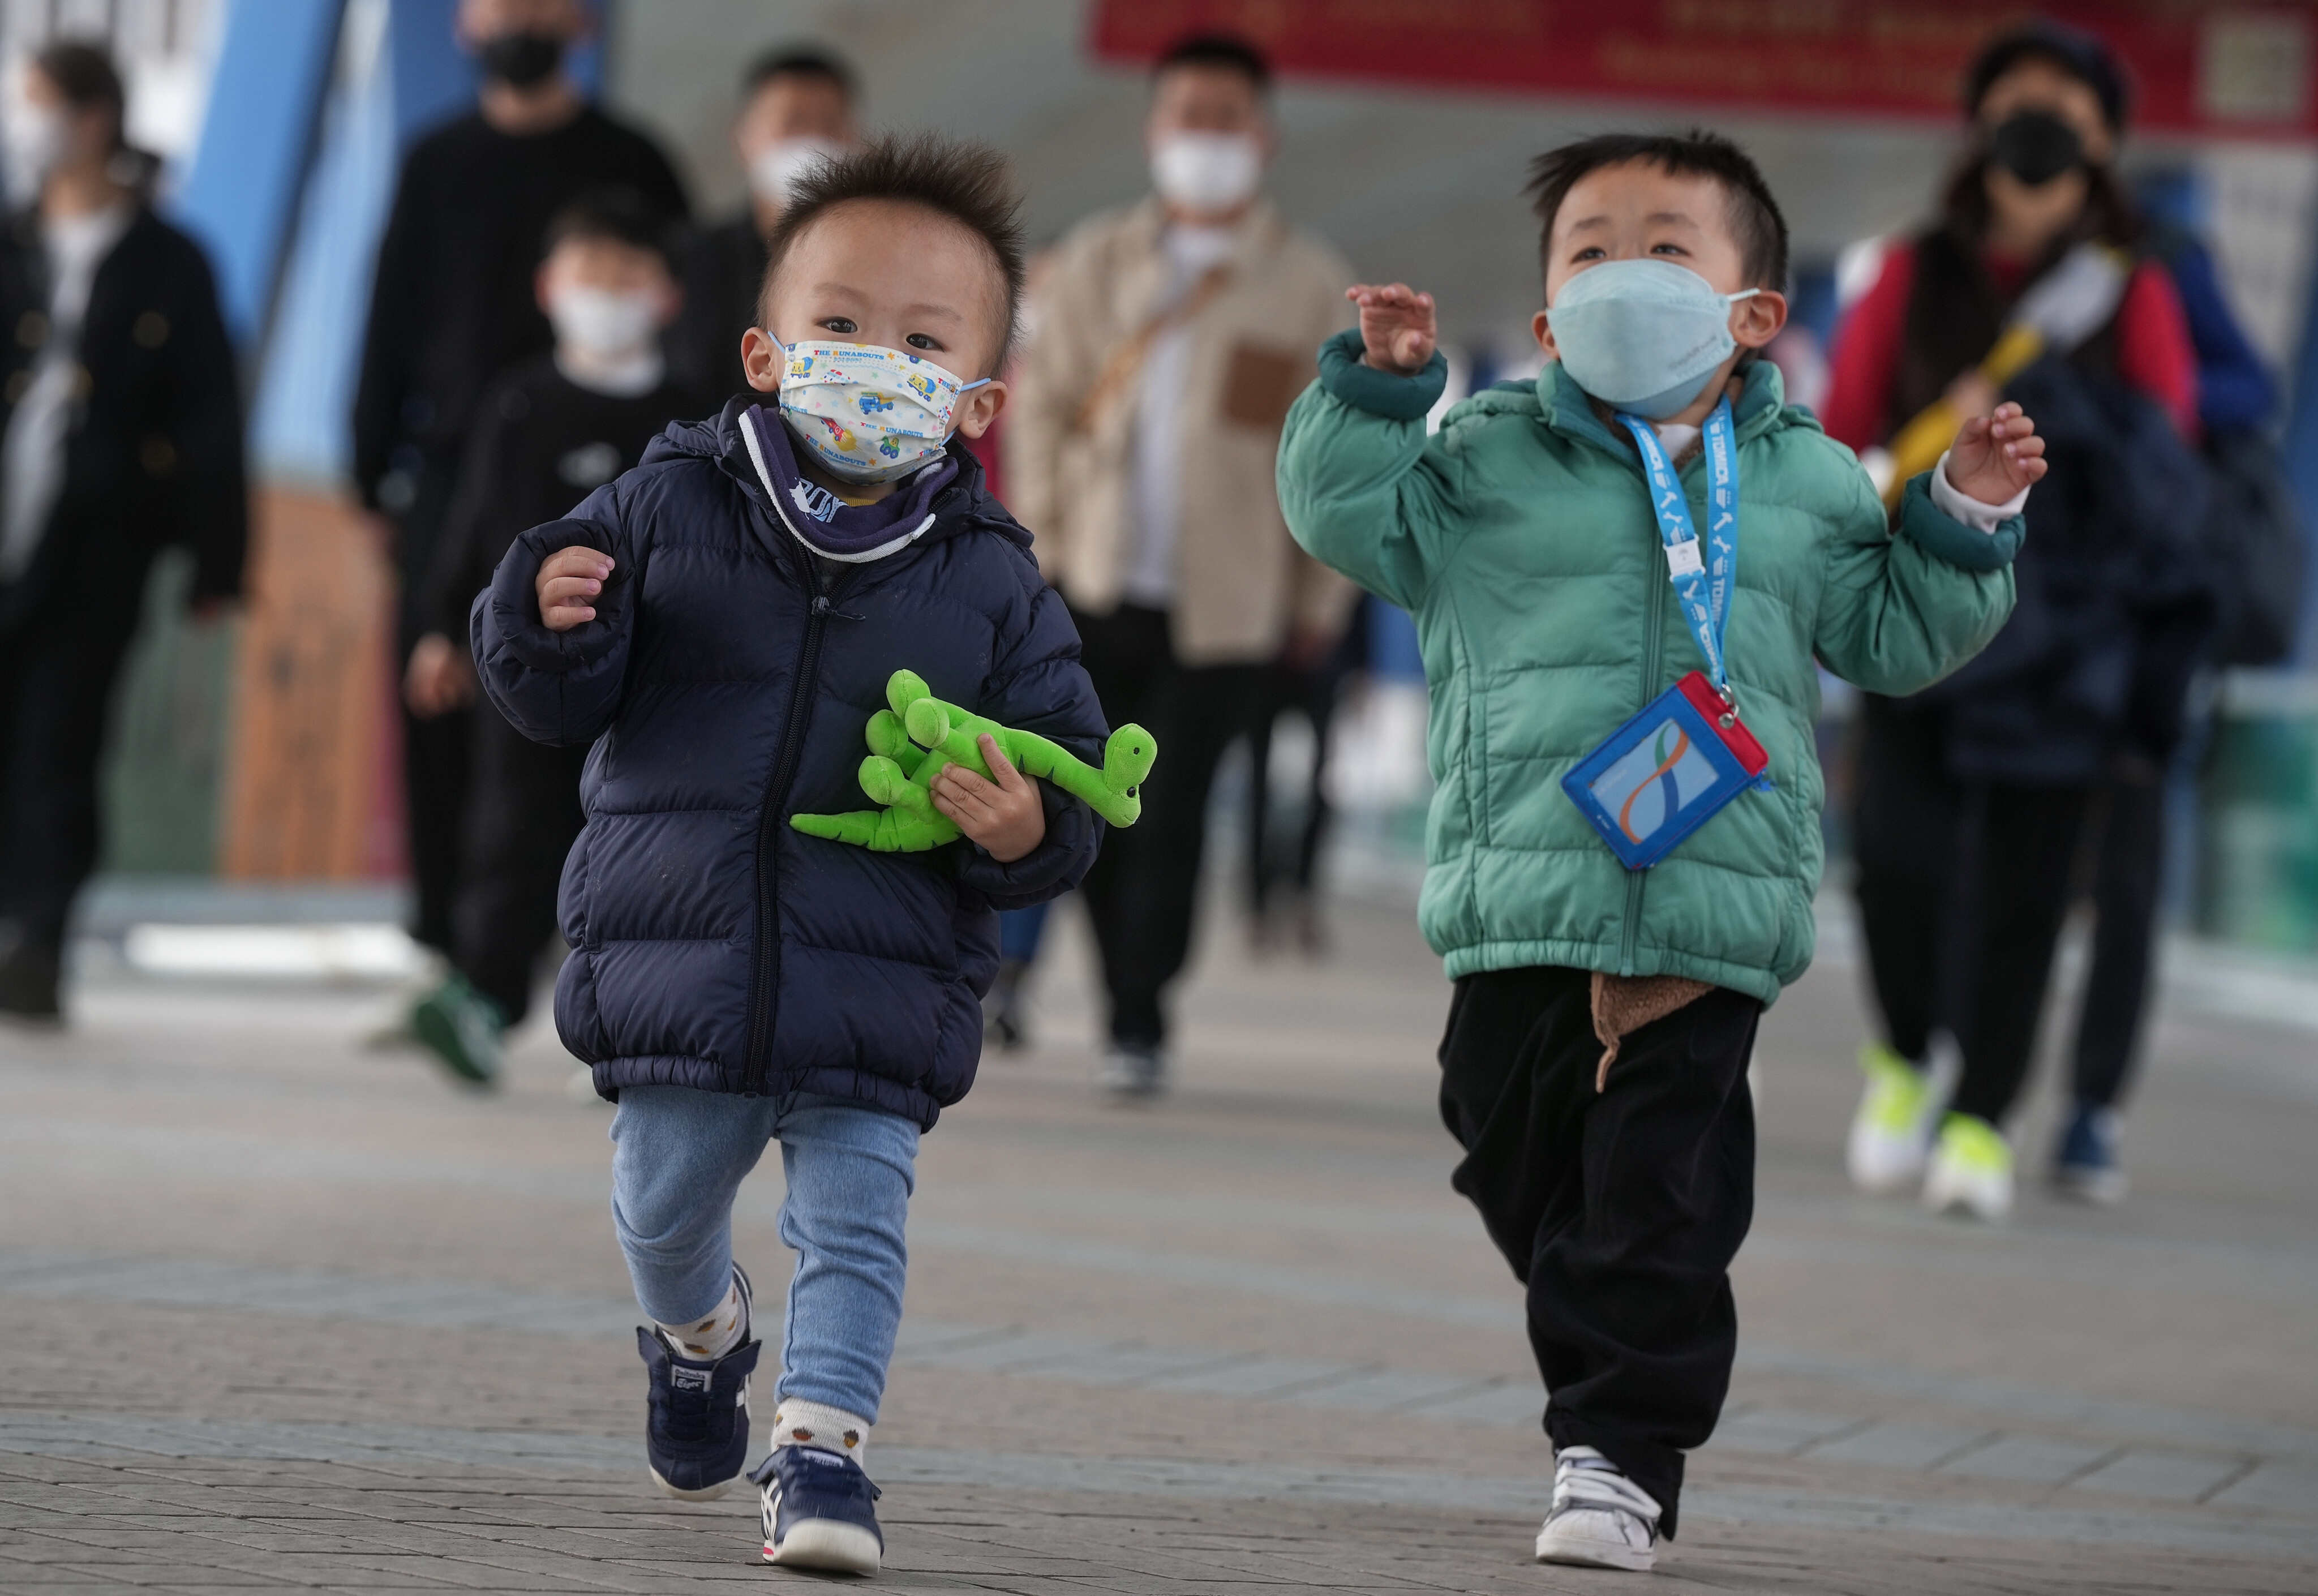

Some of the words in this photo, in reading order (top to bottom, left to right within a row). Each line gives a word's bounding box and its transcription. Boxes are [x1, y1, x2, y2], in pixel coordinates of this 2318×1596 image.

[833, 350, 884, 360] RUNABOUTS
[938, 377, 950, 389] THE
[879, 426, 923, 437] RUNABOUTS
[806, 434, 819, 447] THE
[819, 444, 866, 466] RUNABOUTS
[1711, 434, 1729, 486] TOMICA
[1712, 578, 1725, 631] TOMIC
